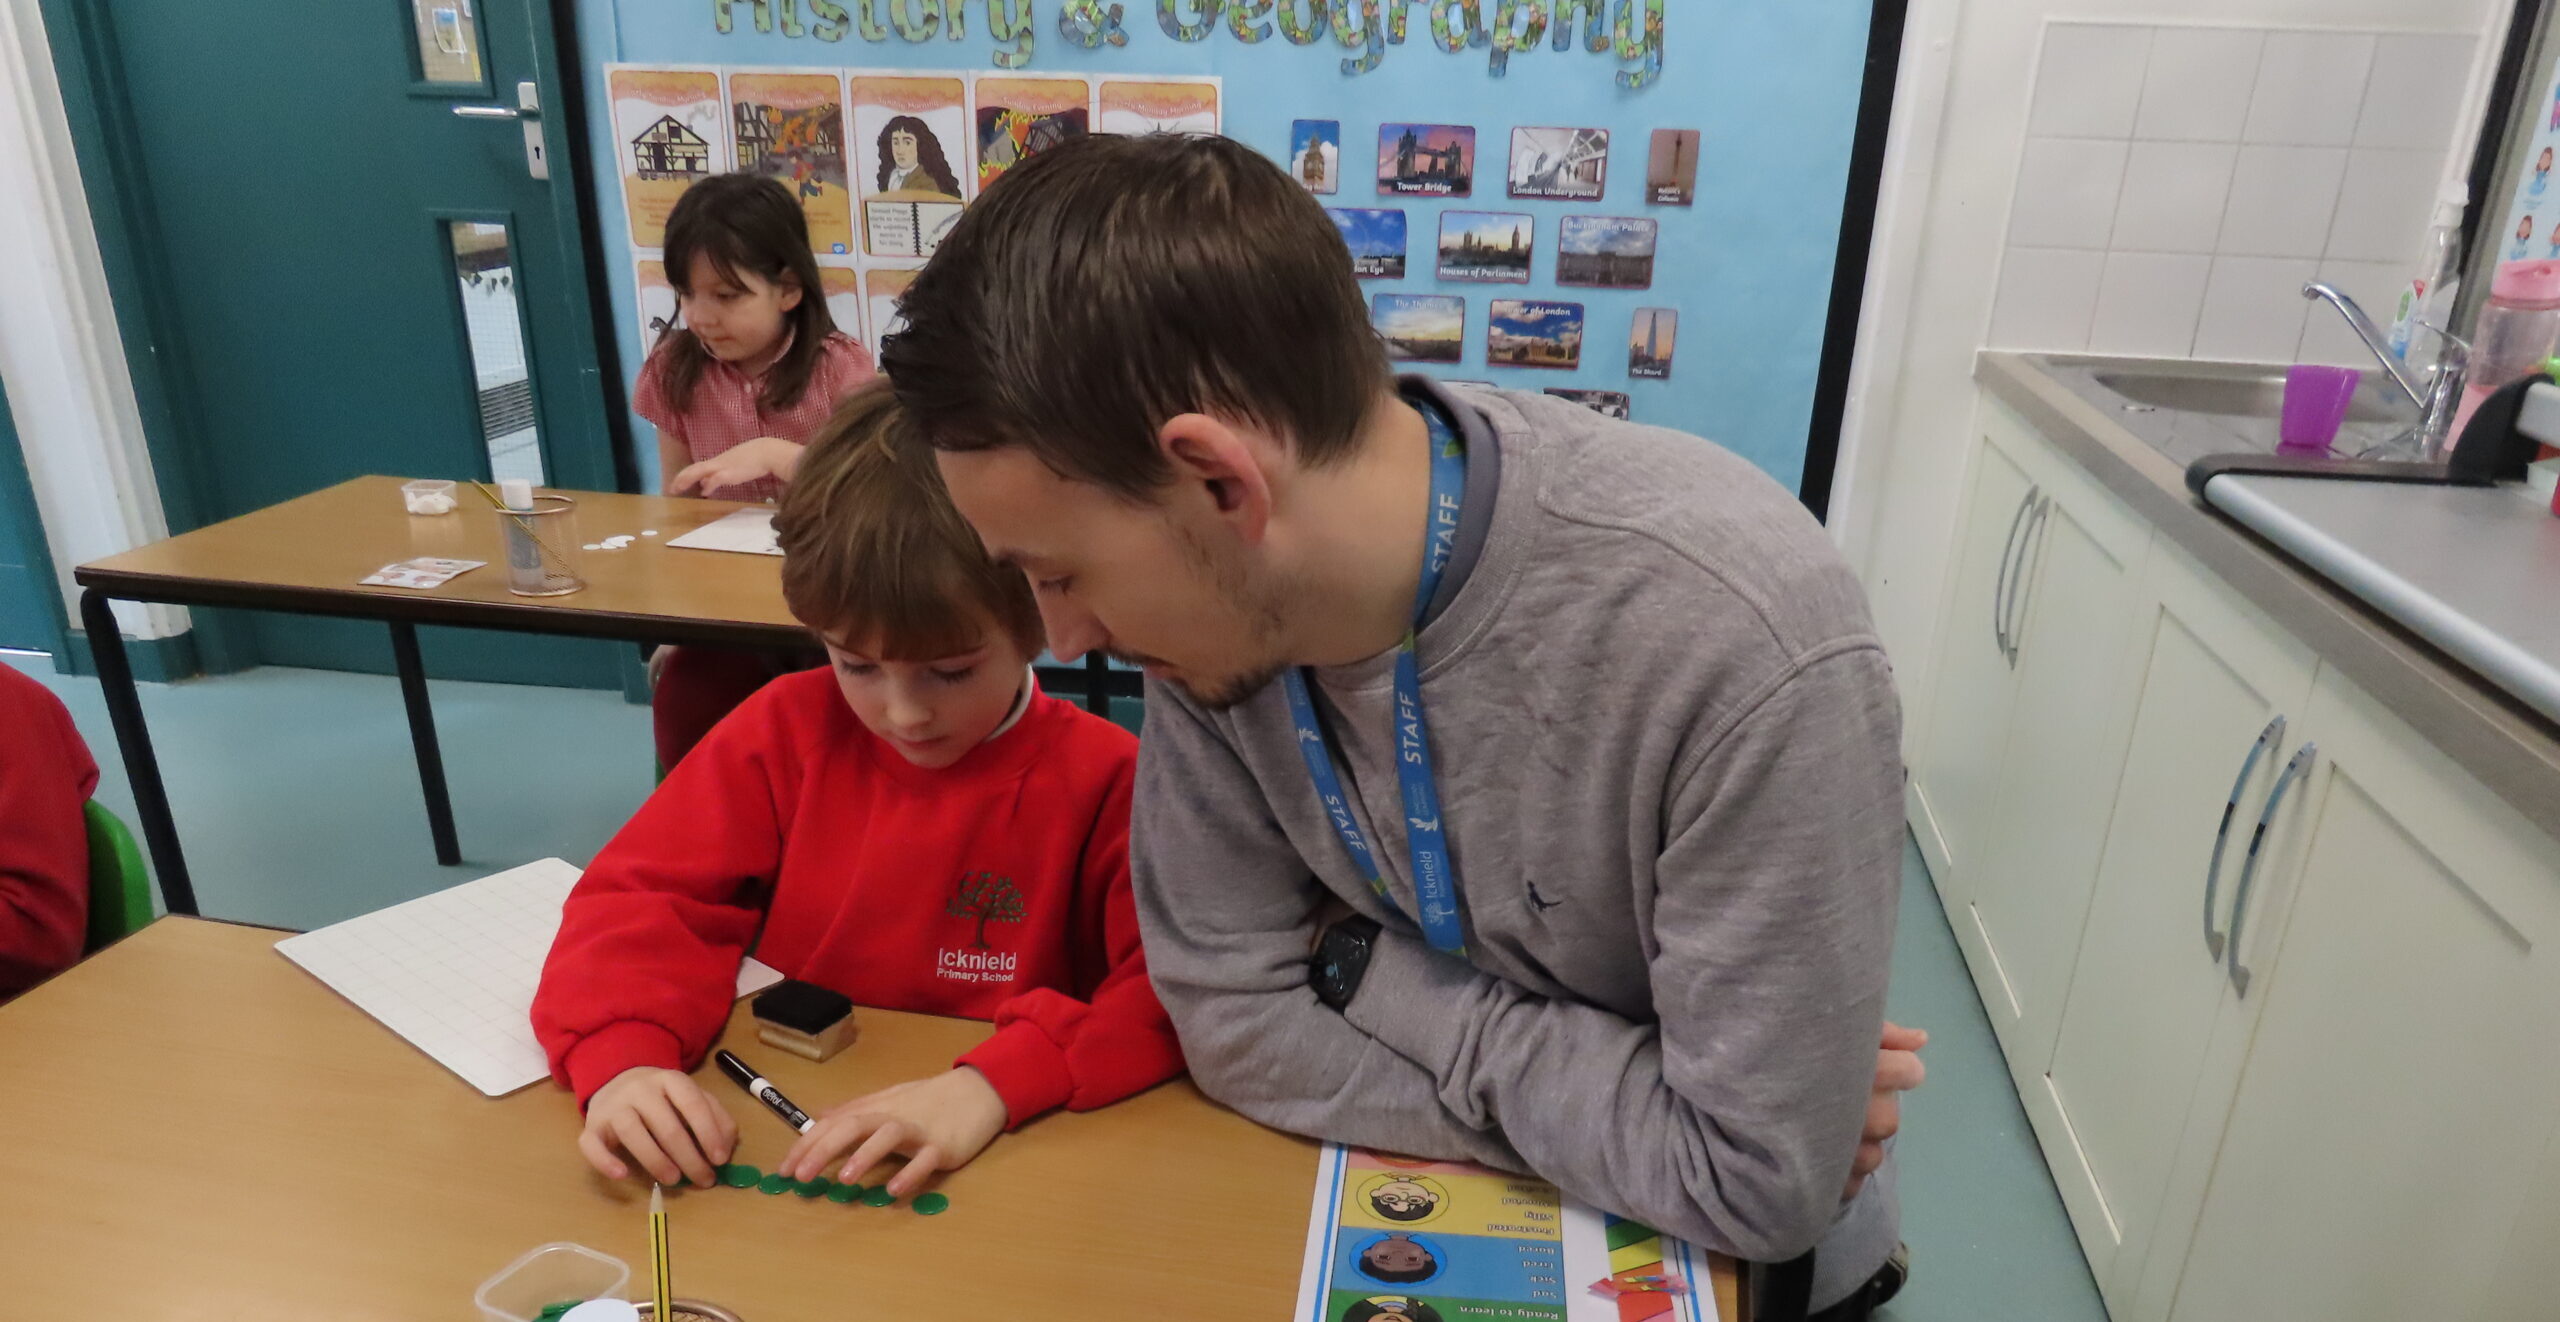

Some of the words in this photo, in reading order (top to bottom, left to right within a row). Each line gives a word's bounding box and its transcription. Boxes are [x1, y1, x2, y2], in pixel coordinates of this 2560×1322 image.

[1058, 0, 1130, 48] &
[1156, 0, 1664, 88] Geography
[1397, 181, 1423, 191] Tower
[1425, 182, 1452, 193] Bridge
[1512, 186, 1542, 195] London
[1544, 187, 1599, 199] Underground
[1369, 265, 1384, 275] Eye
[1440, 267, 1468, 276] Houses
[1470, 267, 1480, 278] of
[1481, 268, 1527, 279] Parliament
[1540, 307, 1571, 316] London
[1432, 493, 1459, 574] STAFF
[1399, 692, 1422, 766] STAFF
[1326, 794, 1367, 851] STAFF
[1419, 850, 1438, 899] Icknield
[938, 947, 1017, 970] Icknield
[937, 967, 979, 982] Primary
[981, 971, 1014, 982] School
[1518, 1246, 1555, 1255] Bored
[1530, 1275, 1556, 1284] Sick
[1532, 1290, 1557, 1299] Sad
[1459, 1306, 1495, 1316] learn
[1517, 1308, 1559, 1320] Ready
